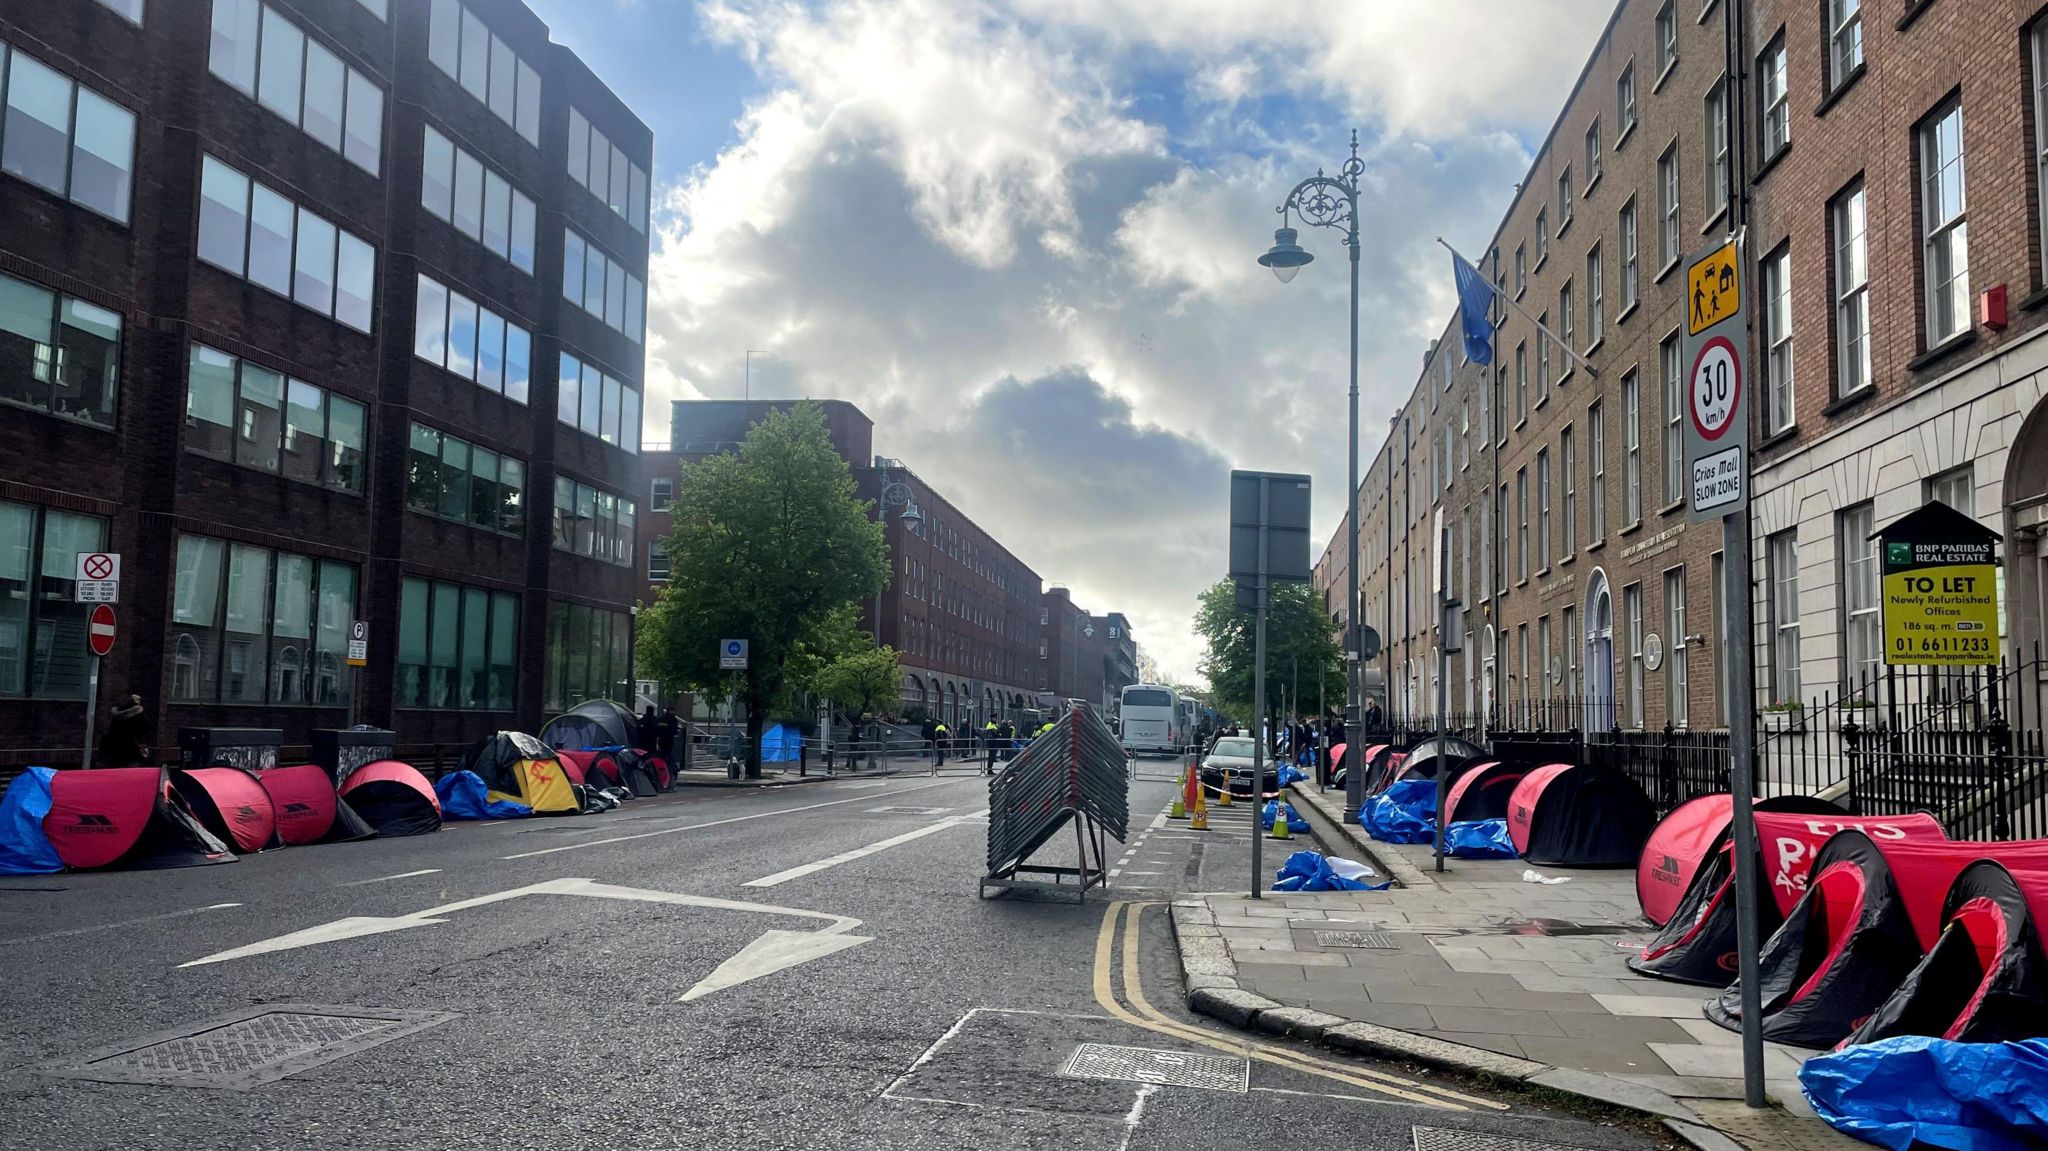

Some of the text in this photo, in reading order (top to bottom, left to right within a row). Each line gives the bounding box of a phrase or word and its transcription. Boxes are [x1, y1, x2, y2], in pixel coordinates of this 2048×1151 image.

[1702, 359, 1727, 407] 30
[1705, 407, 1725, 425] km/h
[1695, 456, 1737, 482] Crios Mall
[1696, 476, 1738, 501] SLOW ZONE
[1915, 544, 1990, 553] BNP PARIBAS
[1916, 554, 1987, 562] REAL ESTATE
[1904, 577, 1976, 593] TO LET
[1891, 596, 1990, 605] Newly Refurbished
[1924, 607, 1961, 616] Offices
[1903, 622, 1921, 630] 186
[1924, 623, 1938, 632] sq.
[1896, 638, 1989, 651] 01 6611233
